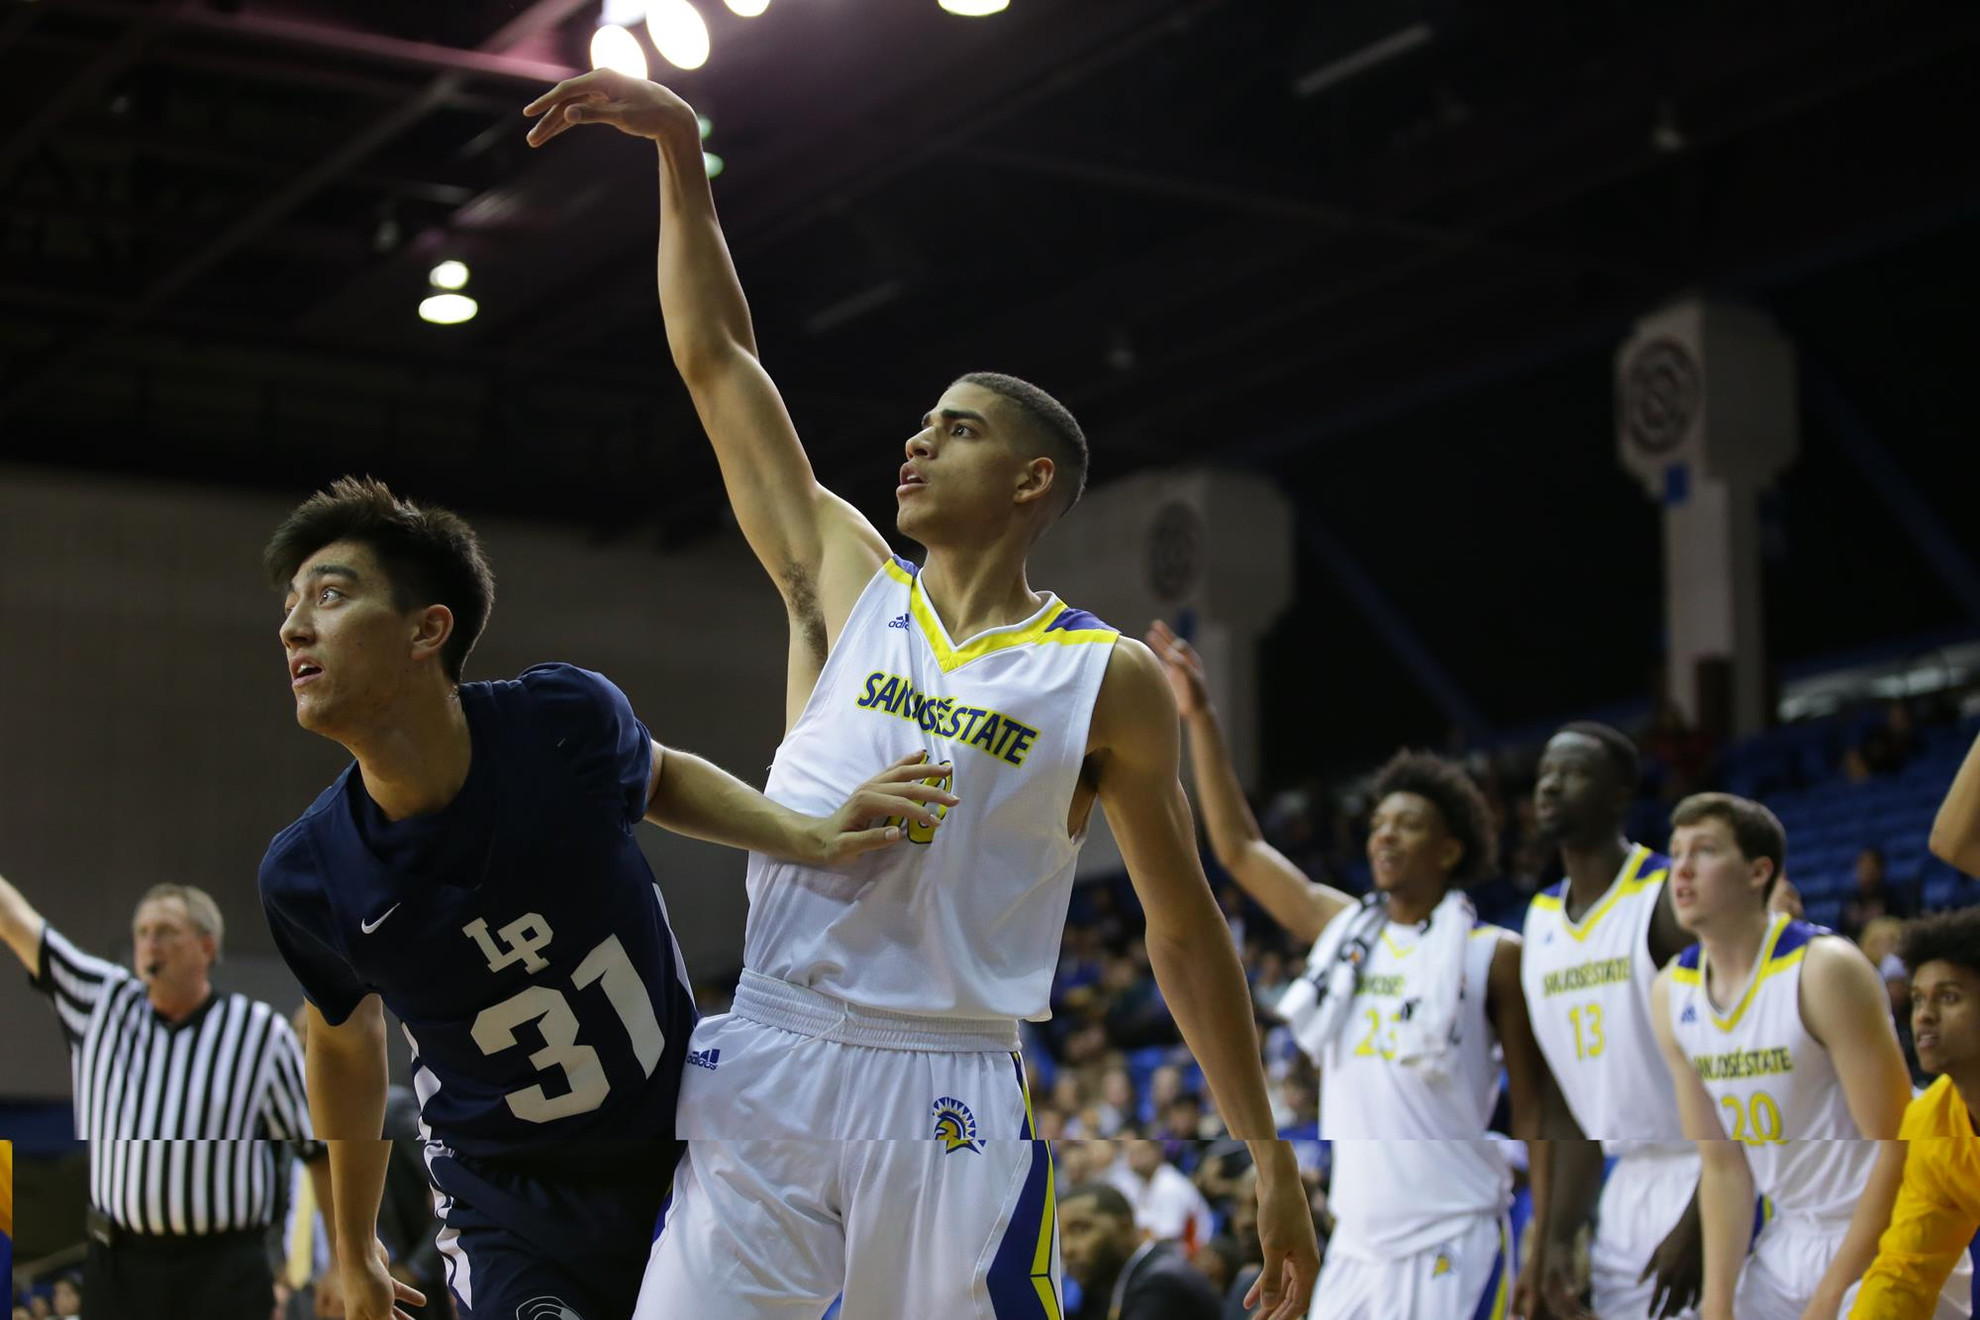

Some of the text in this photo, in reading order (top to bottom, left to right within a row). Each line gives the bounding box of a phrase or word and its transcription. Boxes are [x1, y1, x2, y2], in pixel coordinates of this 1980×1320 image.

[470, 933, 665, 1123] 31
[1569, 1003, 1605, 1061] 13
[1720, 1089, 1789, 1146] 20
